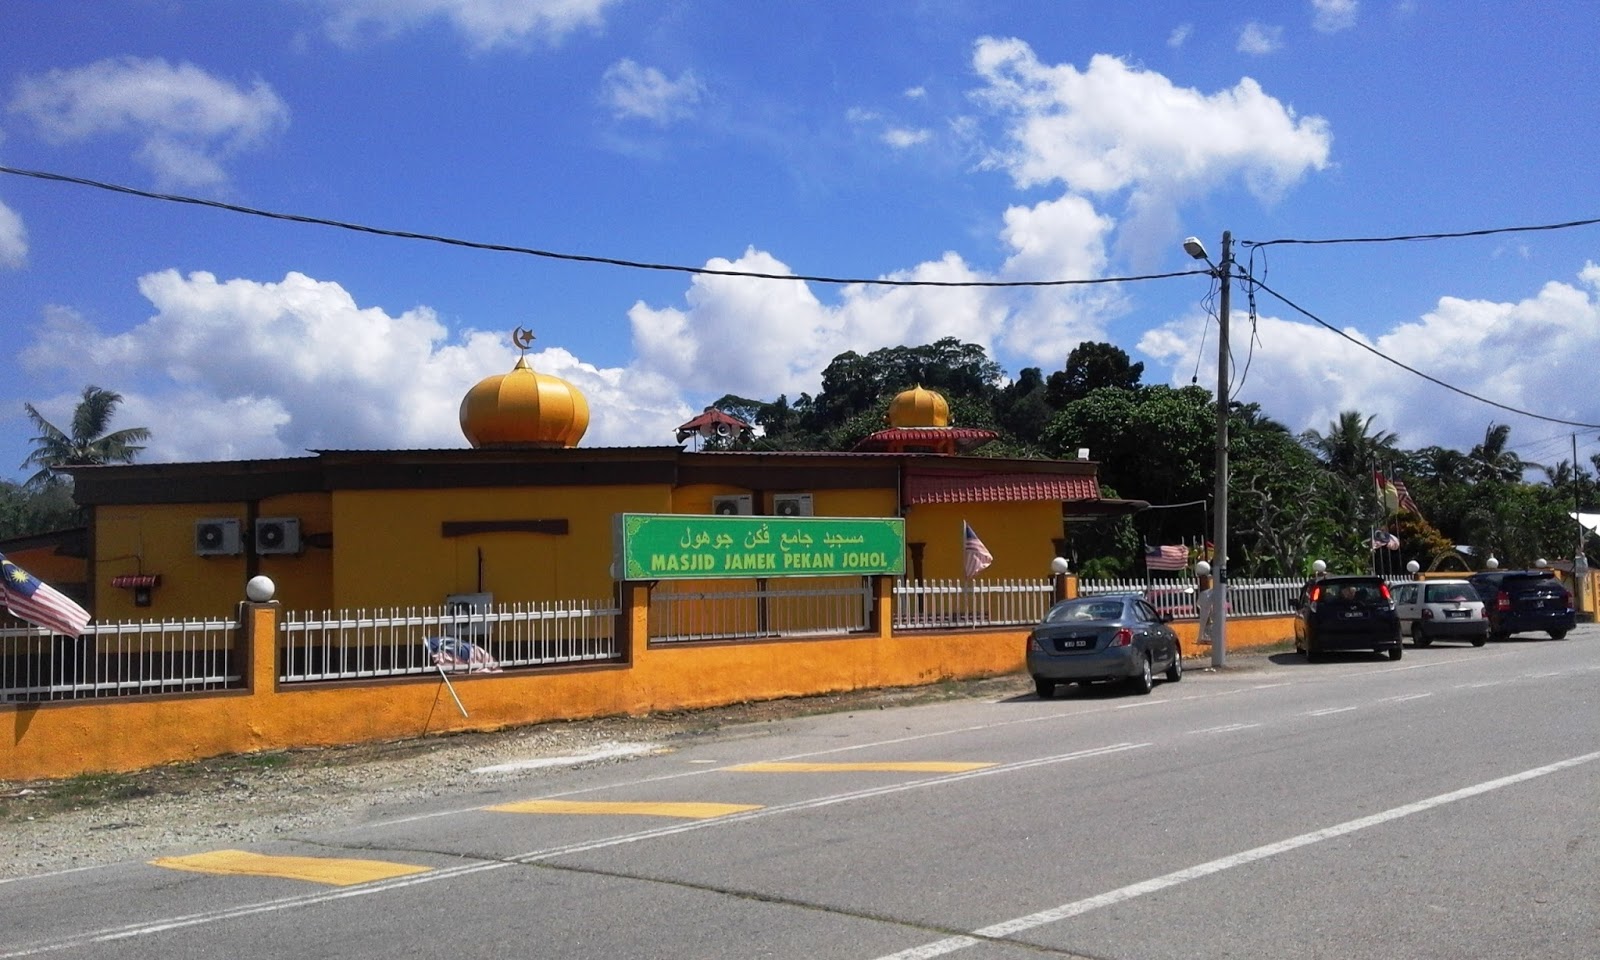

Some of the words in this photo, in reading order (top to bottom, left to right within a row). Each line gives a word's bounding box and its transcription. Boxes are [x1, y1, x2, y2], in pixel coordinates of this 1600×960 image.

[780, 529, 813, 551] جامع
[651, 553, 715, 572] MASJID
[724, 553, 776, 570] JAMEK
[784, 552, 834, 569] PEKAN
[842, 552, 888, 568] JOHOL
